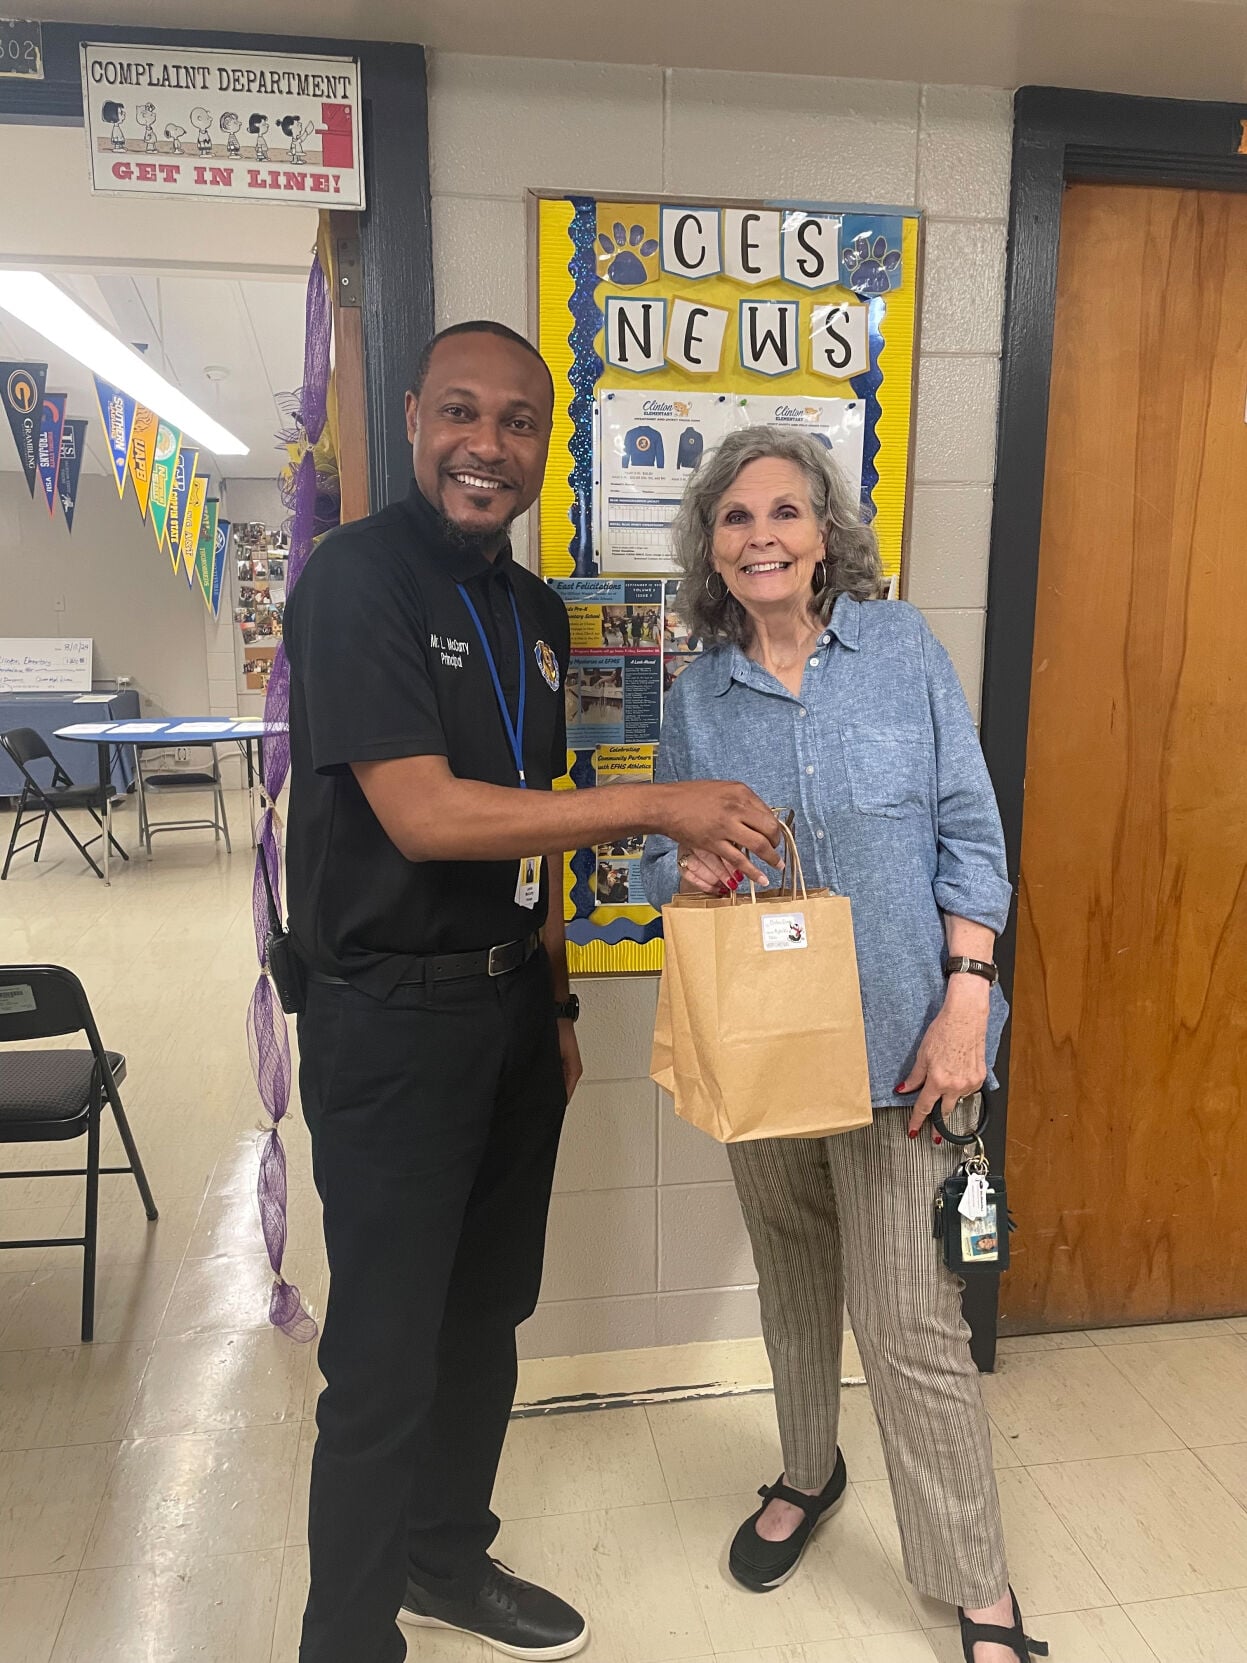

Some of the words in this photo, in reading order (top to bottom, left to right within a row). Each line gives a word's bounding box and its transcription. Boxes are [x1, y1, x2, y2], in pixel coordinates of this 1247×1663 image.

[90, 59, 210, 90] COMPLAINT
[218, 66, 351, 99] DEPARTMENT
[111, 161, 180, 183] GET
[193, 165, 234, 187] IN
[248, 169, 341, 193] LINE!
[673, 213, 824, 278] CES
[617, 303, 852, 369] NEWS
[642, 399, 673, 411] Clinton
[774, 405, 804, 417] Clinton
[113, 396, 126, 451] SOUTHERN
[23, 418, 35, 469] GRAMBLING
[38, 431, 49, 468] TROJANS
[133, 440, 147, 482] UAPB
[45, 476, 53, 493] VSU
[169, 490, 179, 519] COPPIN
[170, 520, 179, 544] STATE
[185, 530, 194, 557] A&T
[556, 581, 575, 590] East
[576, 581, 621, 590] Felicitations
[430, 633, 440, 648] Mr.
